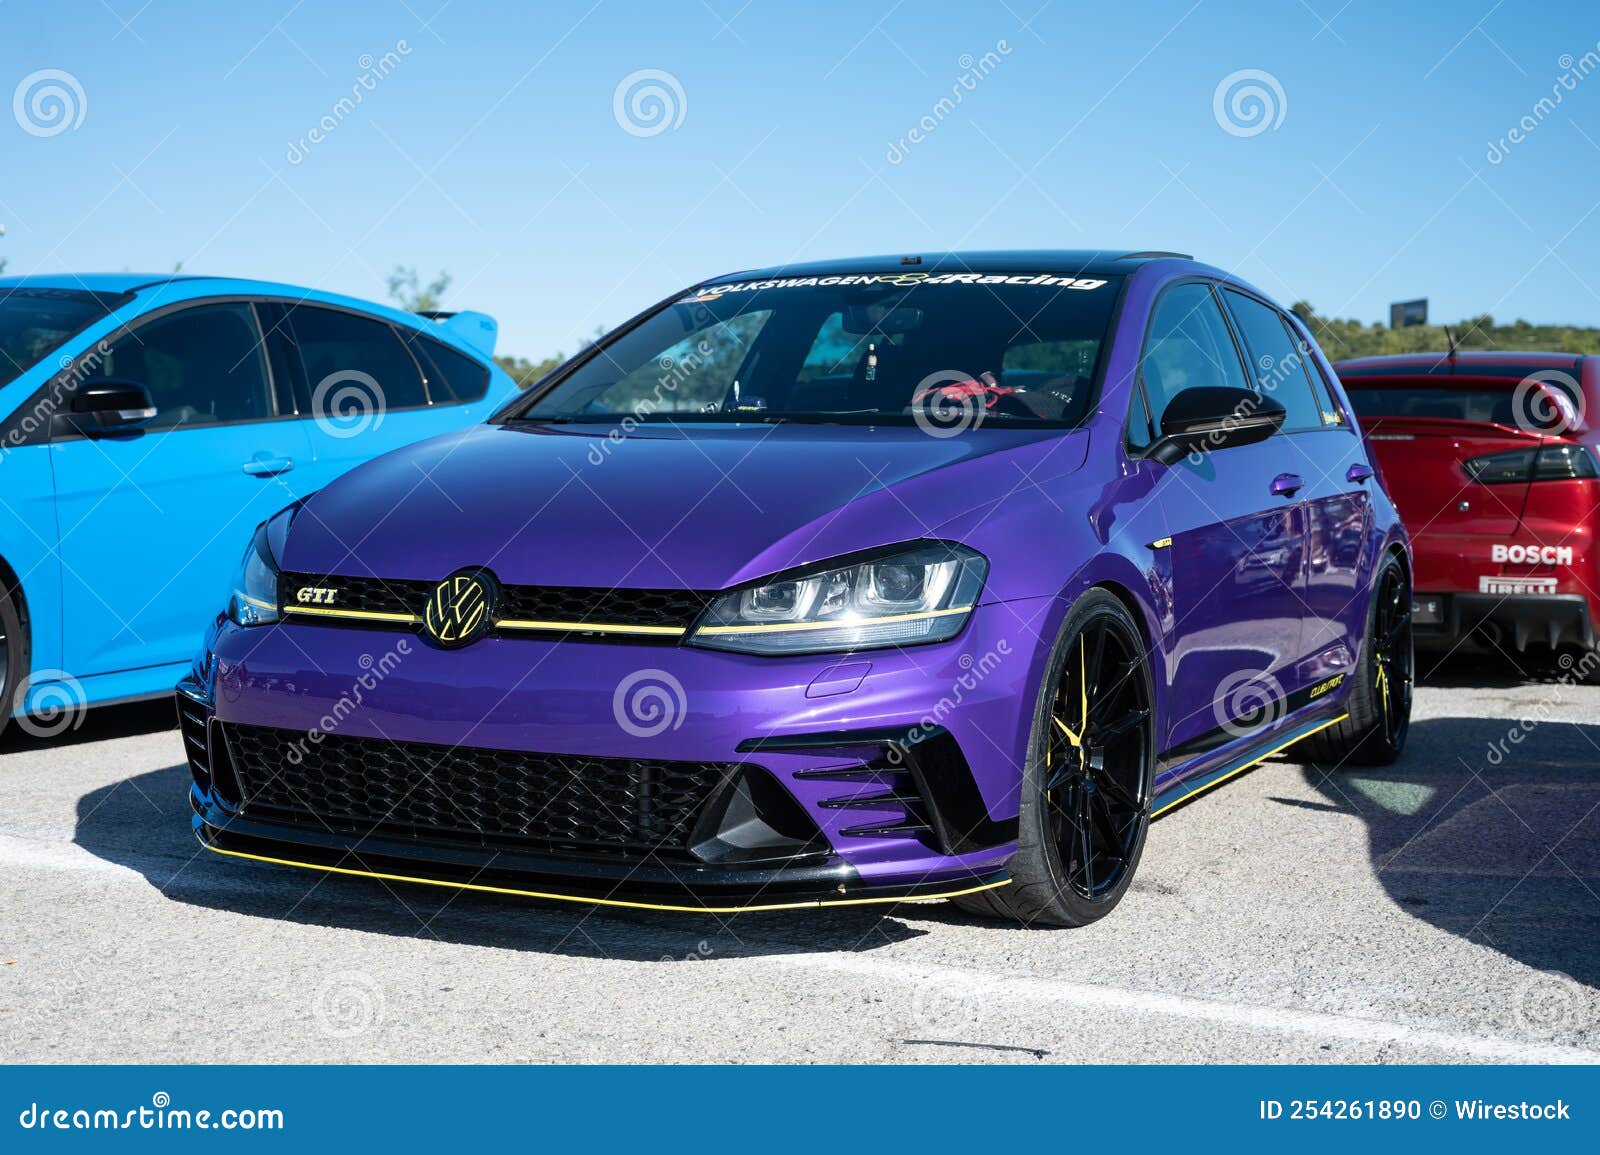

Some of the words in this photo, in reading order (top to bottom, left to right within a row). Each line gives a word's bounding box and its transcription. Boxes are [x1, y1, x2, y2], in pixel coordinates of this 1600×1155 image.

[697, 275, 880, 296] VOLKSWAGEN
[926, 273, 1108, 290] Racing
[1491, 544, 1574, 566] BOSCH
[1479, 575, 1559, 594] PIRELLI
[296, 587, 338, 604] GTI
